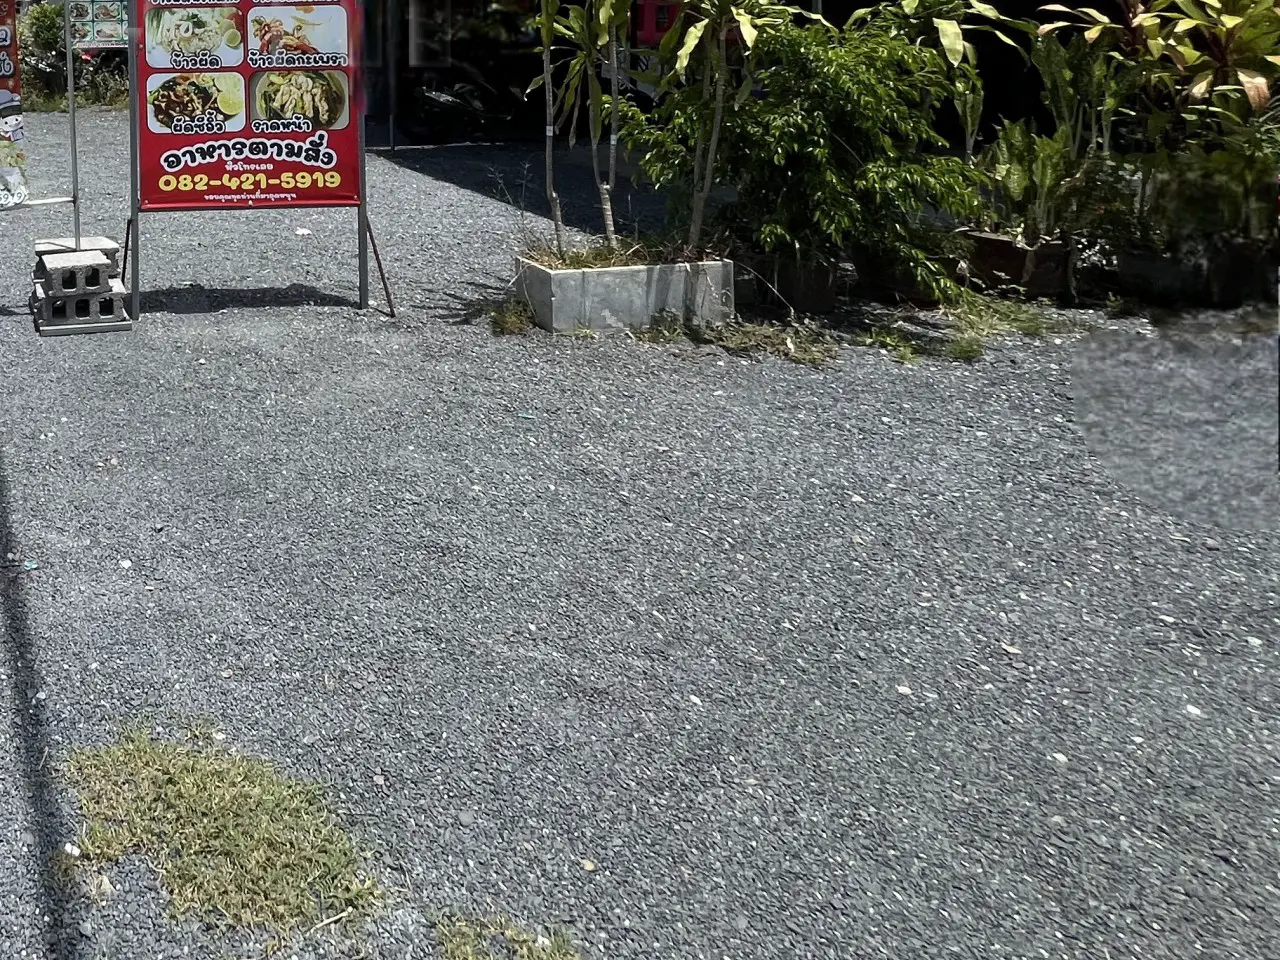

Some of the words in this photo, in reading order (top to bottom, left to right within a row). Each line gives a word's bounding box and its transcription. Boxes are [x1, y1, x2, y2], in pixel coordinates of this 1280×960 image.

[171, 52, 222, 69] ข้าวผัด
[251, 116, 313, 133] ราดหน้า
[161, 131, 337, 172] อาหารตามสั่ง
[158, 171, 342, 191] 082-421-5919
